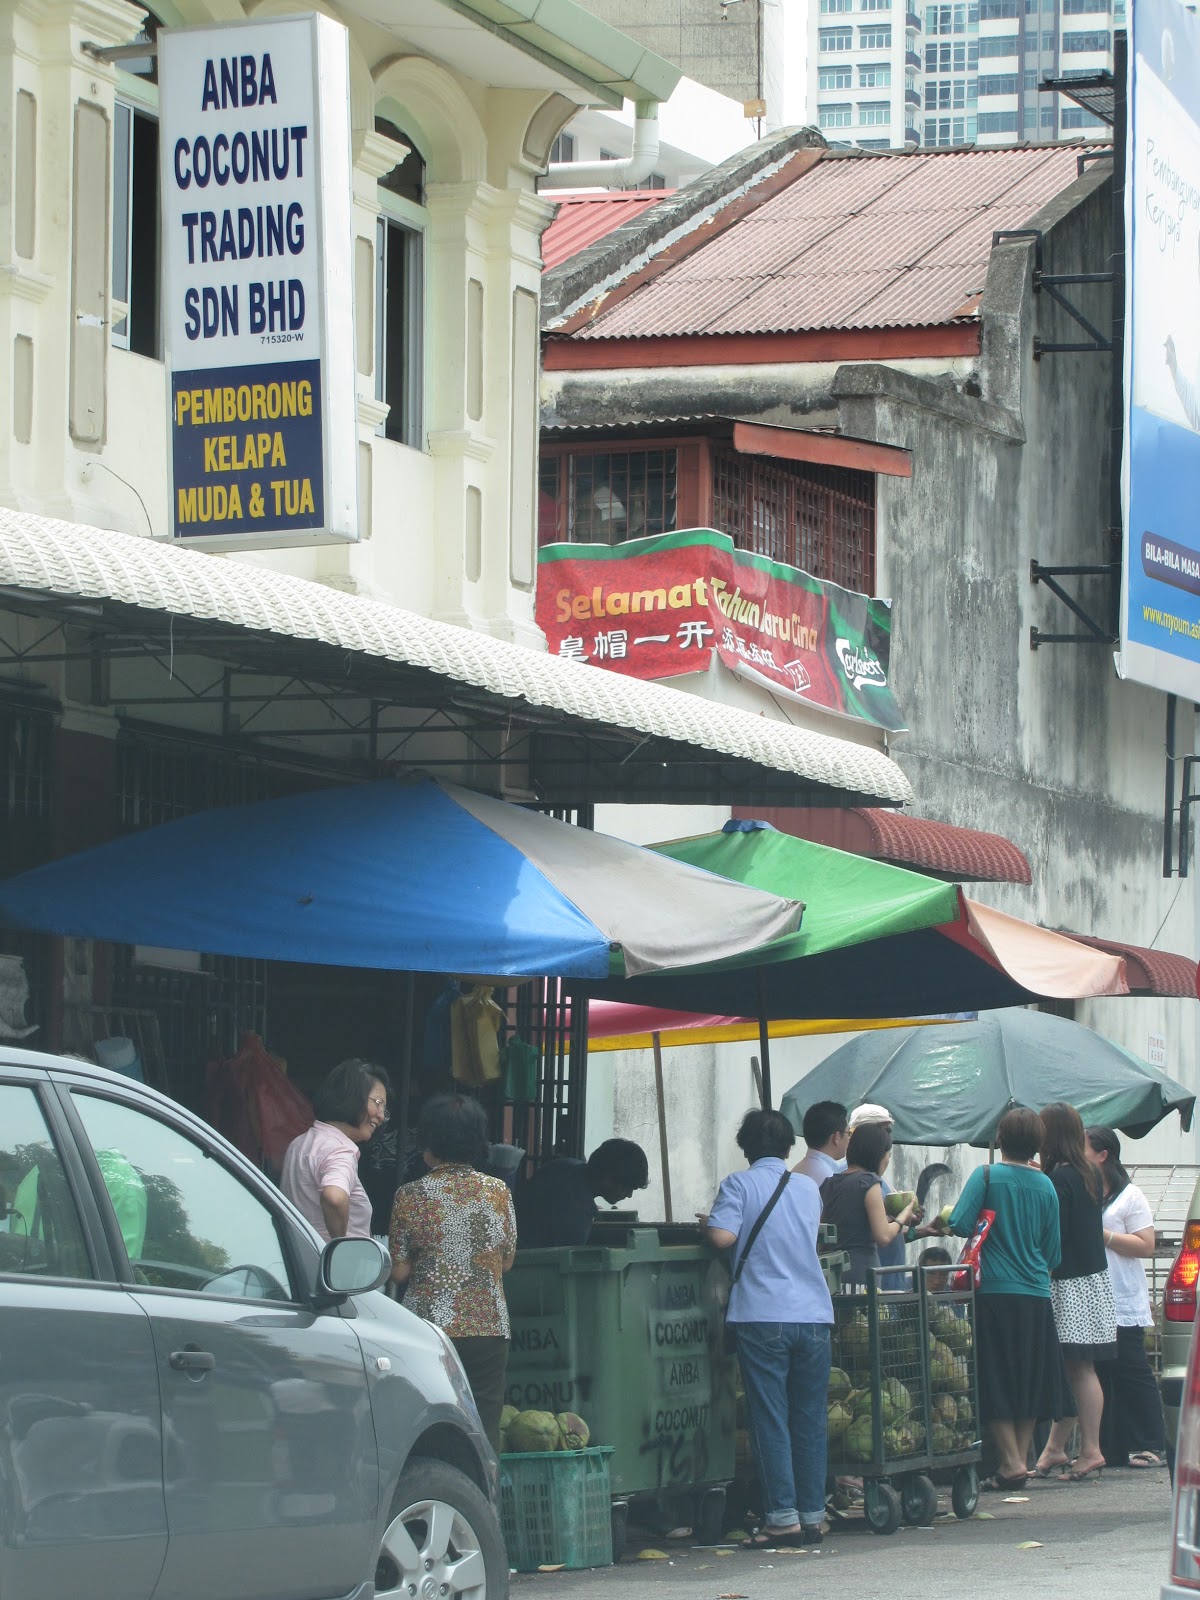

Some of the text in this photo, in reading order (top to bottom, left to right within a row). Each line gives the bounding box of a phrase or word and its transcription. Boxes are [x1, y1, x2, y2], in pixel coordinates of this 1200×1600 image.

[202, 53, 277, 111] ANBA
[174, 126, 307, 190] COCONUT
[182, 202, 304, 264] TRADING
[1145, 186, 1181, 260] Kerjaya
[184, 279, 305, 341] SDN BHD
[260, 333, 304, 345] 715320-W
[176, 380, 312, 426] PEMBORONG
[204, 432, 286, 472] KELAPA
[178, 478, 314, 523] MUDA & TUA
[1145, 542, 1180, 571] BILA-BILA
[556, 576, 709, 623] Selamat
[710, 577, 760, 628] Tahun
[792, 613, 817, 652] Cina
[508, 1328, 560, 1352] NBA
[669, 1362, 700, 1386] ANBA
[655, 1404, 709, 1432] COCONUT
